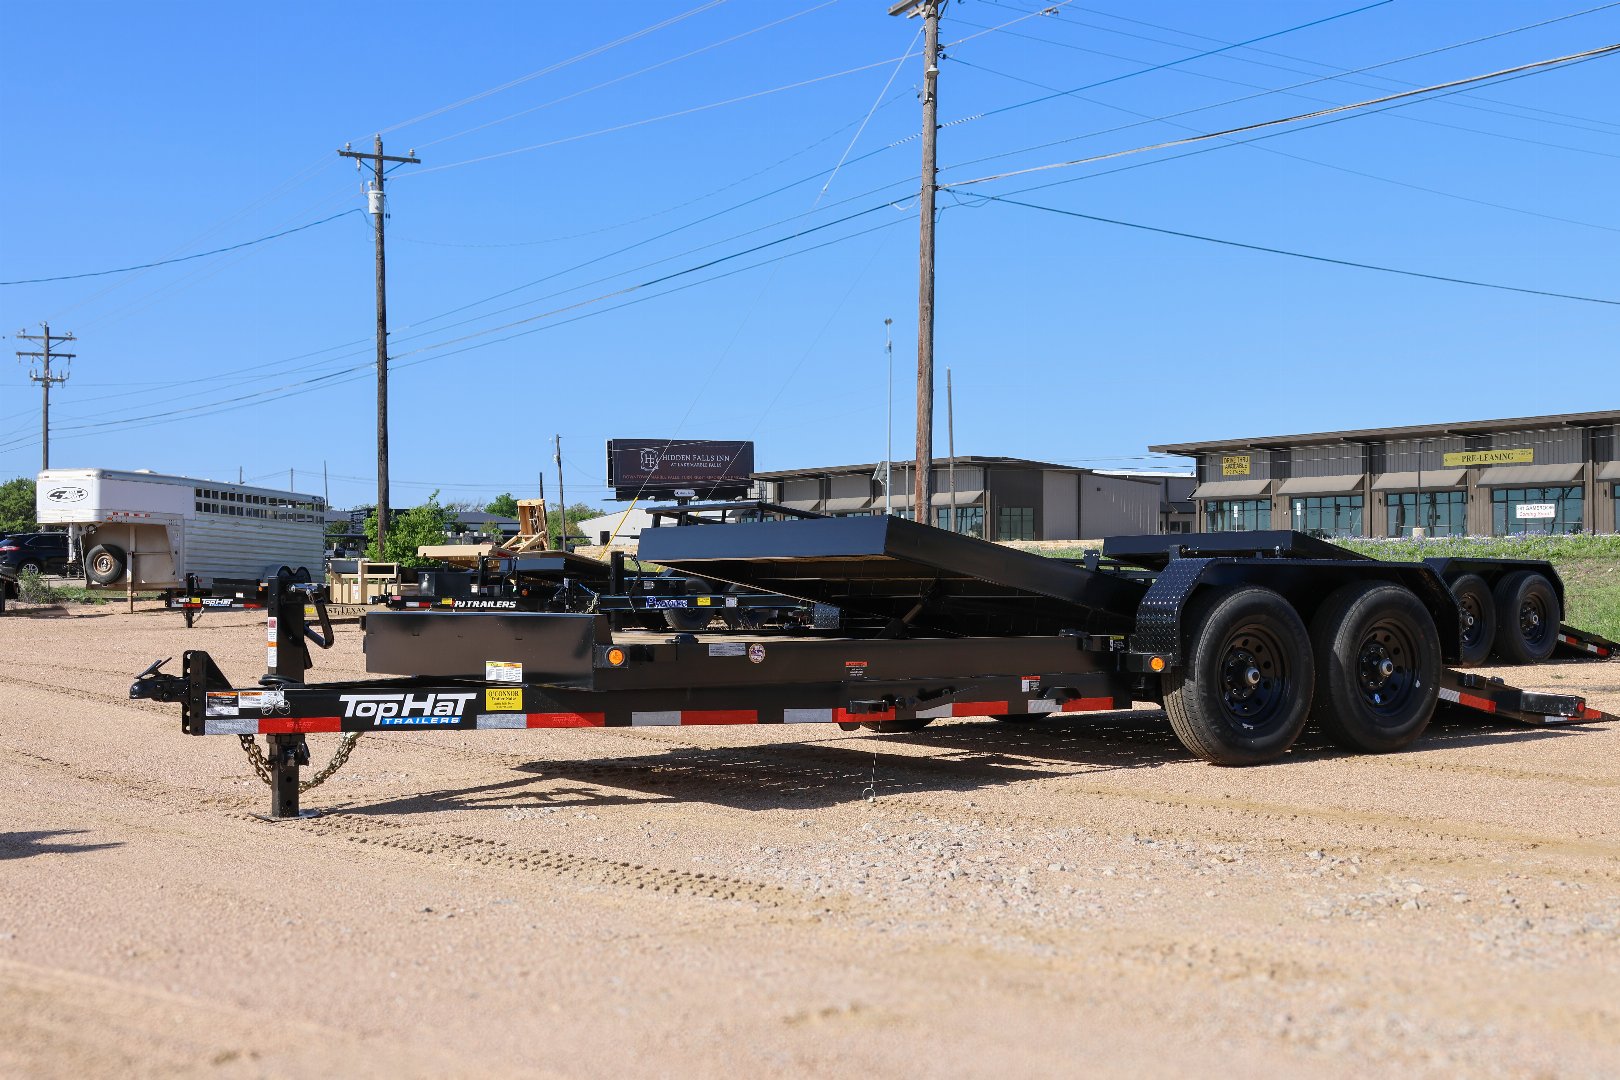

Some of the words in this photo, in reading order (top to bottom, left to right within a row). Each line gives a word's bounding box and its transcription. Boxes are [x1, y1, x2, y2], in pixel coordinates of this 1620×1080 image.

[692, 454, 715, 462] FALLS
[1461, 452, 1514, 462] PRE-LEASING
[466, 600, 517, 608] TRAILERS
[339, 606, 366, 614] TEXAS
[385, 716, 460, 725] TRAILERS
